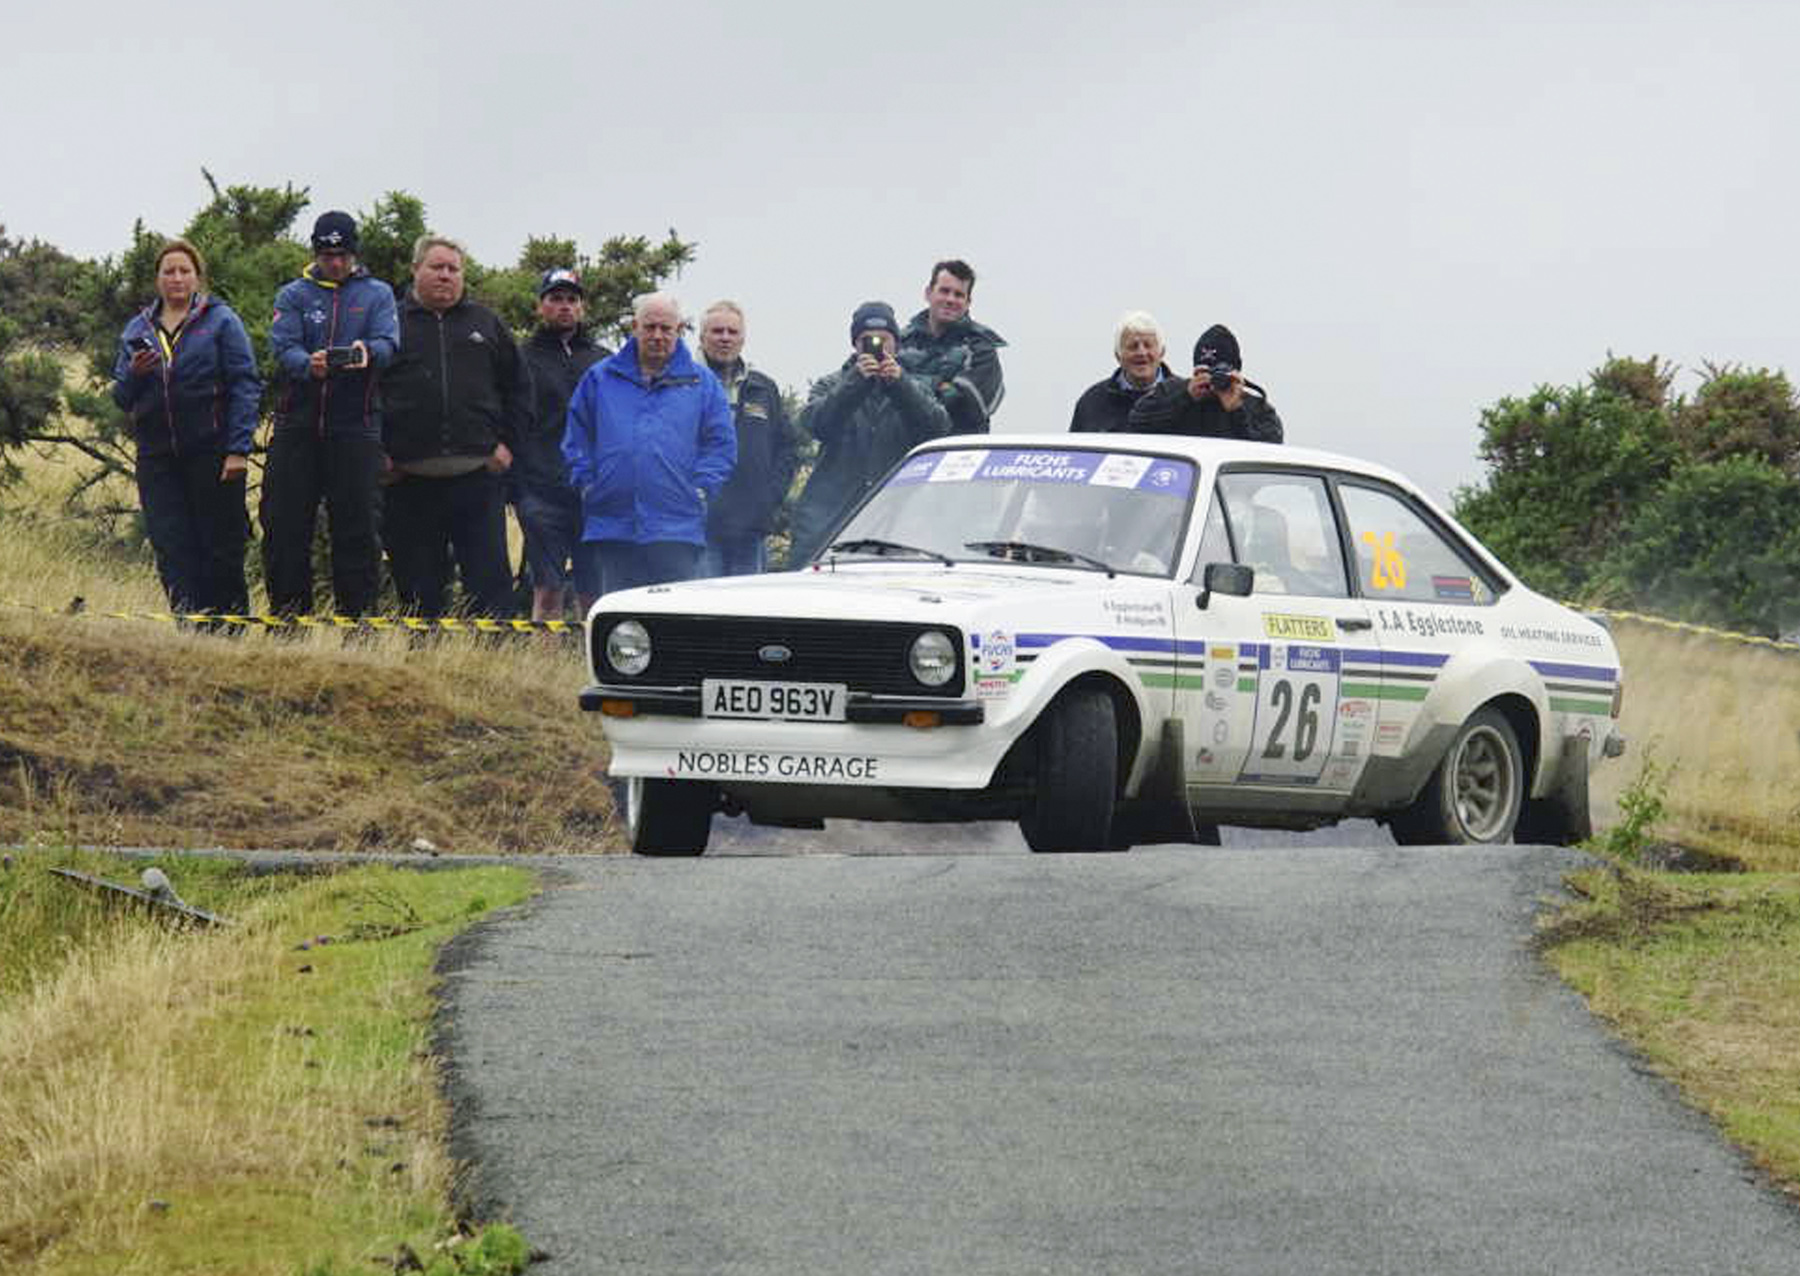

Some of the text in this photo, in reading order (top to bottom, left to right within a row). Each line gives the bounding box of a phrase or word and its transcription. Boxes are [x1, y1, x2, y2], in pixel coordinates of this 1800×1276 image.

[982, 465, 1088, 480] LUBRICANTS
[1014, 453, 1072, 466] FUCHS
[1361, 530, 1406, 590] 26
[1267, 617, 1329, 637] PLATTERS
[714, 685, 835, 716] AEO 963V
[1261, 680, 1321, 761] 26
[678, 752, 878, 778] NOBLES GARAGE
